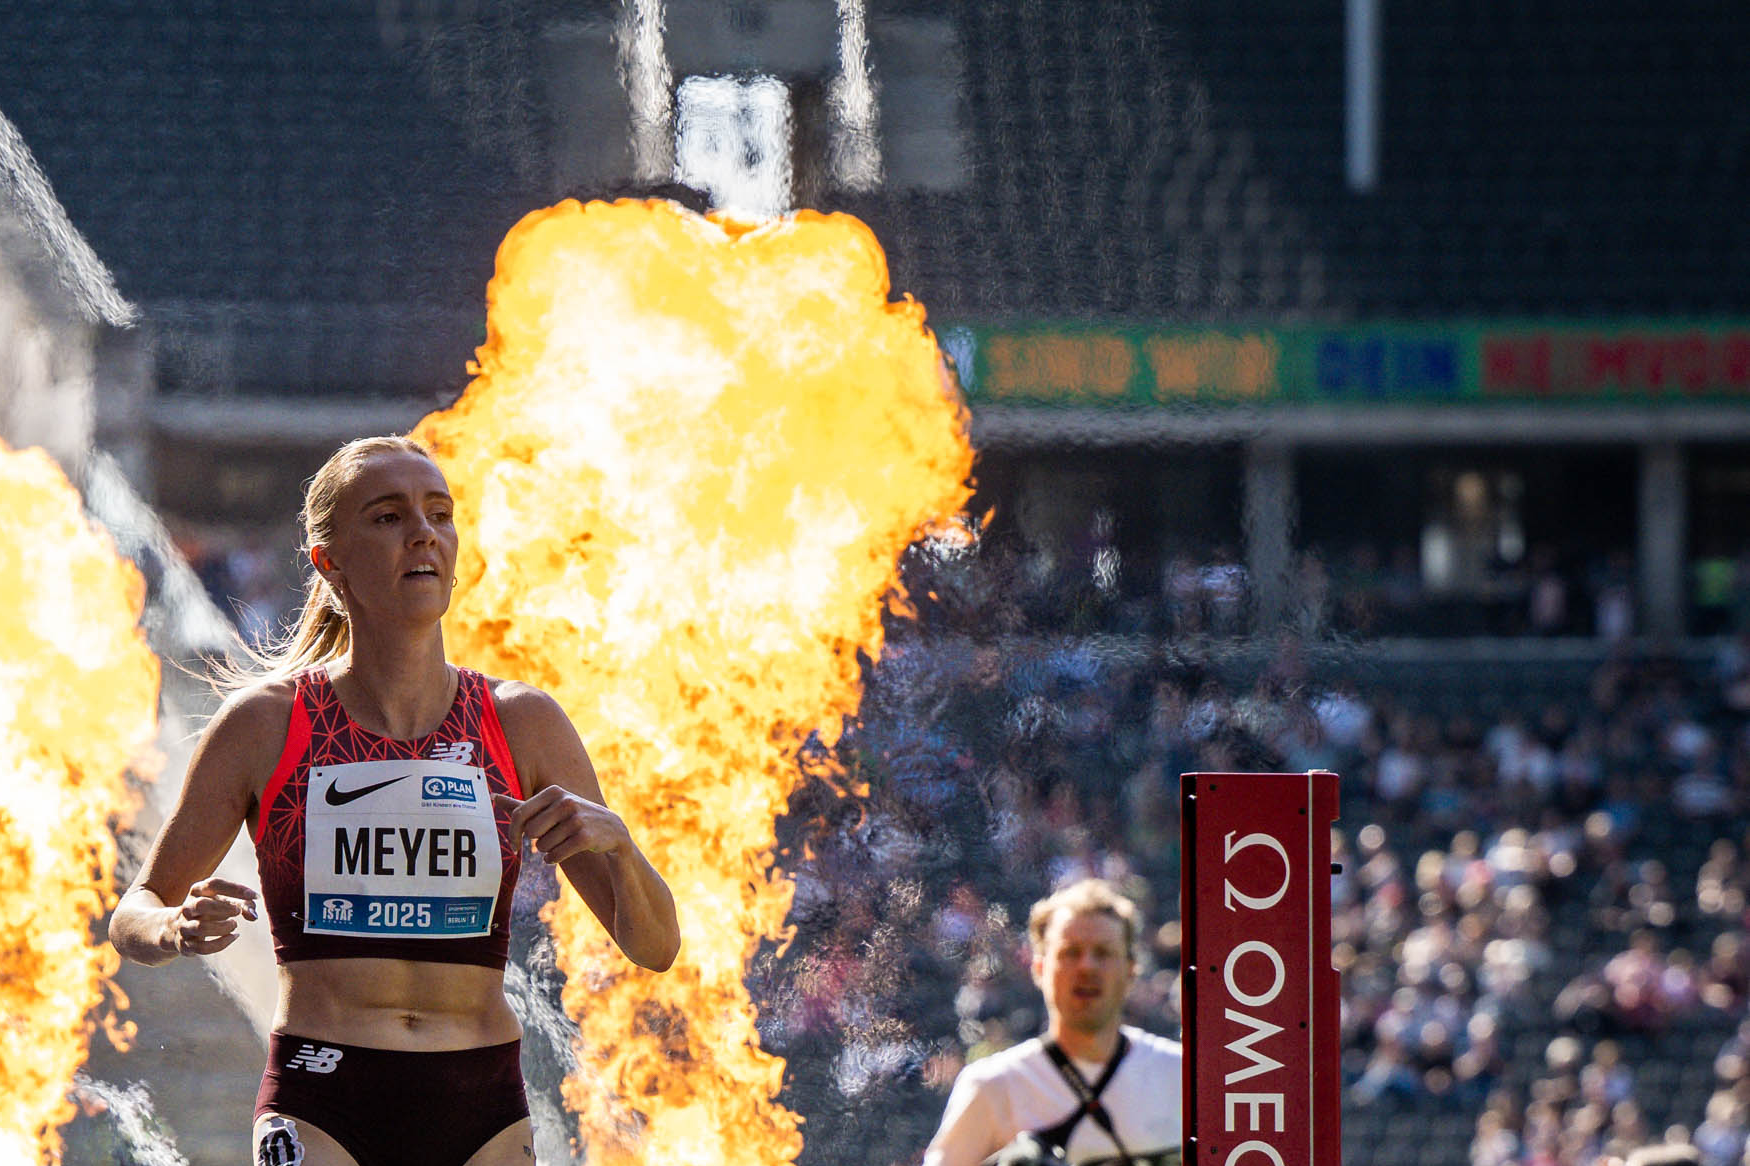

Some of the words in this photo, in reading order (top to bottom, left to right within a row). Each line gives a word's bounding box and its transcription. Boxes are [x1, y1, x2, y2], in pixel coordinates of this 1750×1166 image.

[447, 780, 473, 794] PLAN
[333, 827, 477, 878] MEYER
[322, 907, 354, 921] ISTAF
[367, 902, 431, 928] 2025
